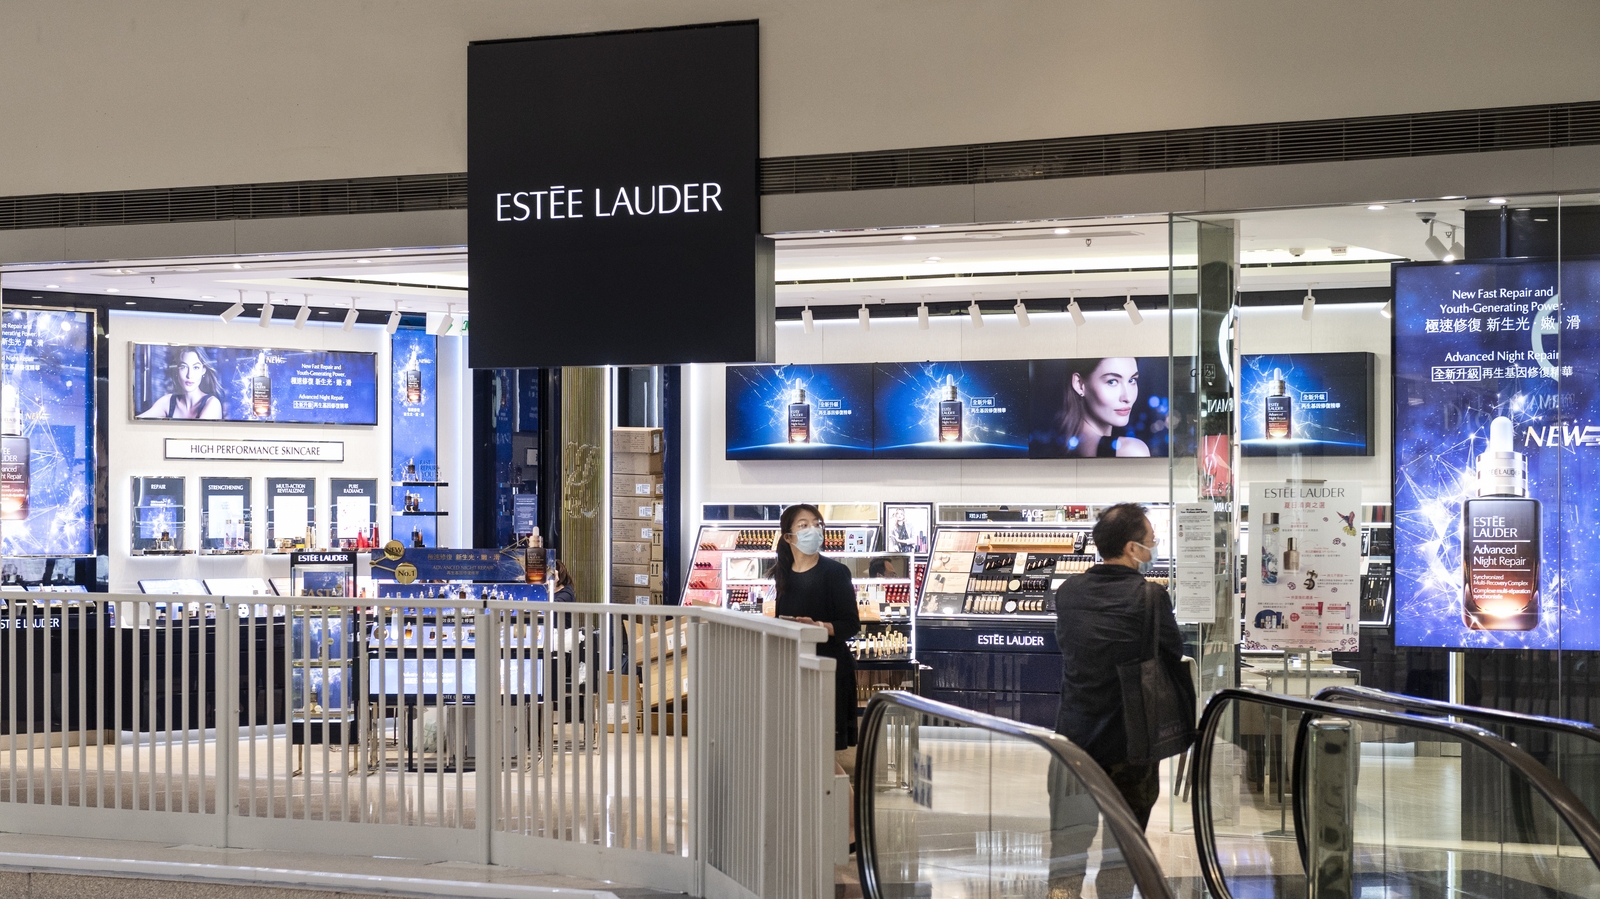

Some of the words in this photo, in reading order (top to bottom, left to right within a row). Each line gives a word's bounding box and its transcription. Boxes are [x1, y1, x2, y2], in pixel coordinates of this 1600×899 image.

[595, 182, 723, 217] LAUDER
[1452, 290, 1476, 300] New
[1478, 288, 1498, 299] Fast
[1499, 287, 1532, 300] Repair
[1534, 286, 1554, 297] and
[1440, 303, 1529, 314] Youth-Generating
[1425, 318, 1482, 333] 極速修復
[1444, 351, 1495, 362] Advanced
[1496, 351, 1525, 363] Night
[1527, 350, 1559, 362] Repair
[1434, 369, 1479, 380] 全新升級
[1524, 425, 1587, 447] NEW
[190, 444, 214, 454] HIGH
[216, 445, 279, 456] PERFORMANCE
[281, 447, 321, 456] SKINCARE
[1300, 487, 1345, 498] LAUDER
[1021, 509, 1043, 518] FACE
[1473, 528, 1518, 538] LAUDER
[1473, 545, 1517, 555] Advanced
[1473, 556, 1497, 568] Night
[1499, 557, 1526, 568] Repair
[397, 569, 416, 577] No.1
[1006, 635, 1044, 646] LAUDER
